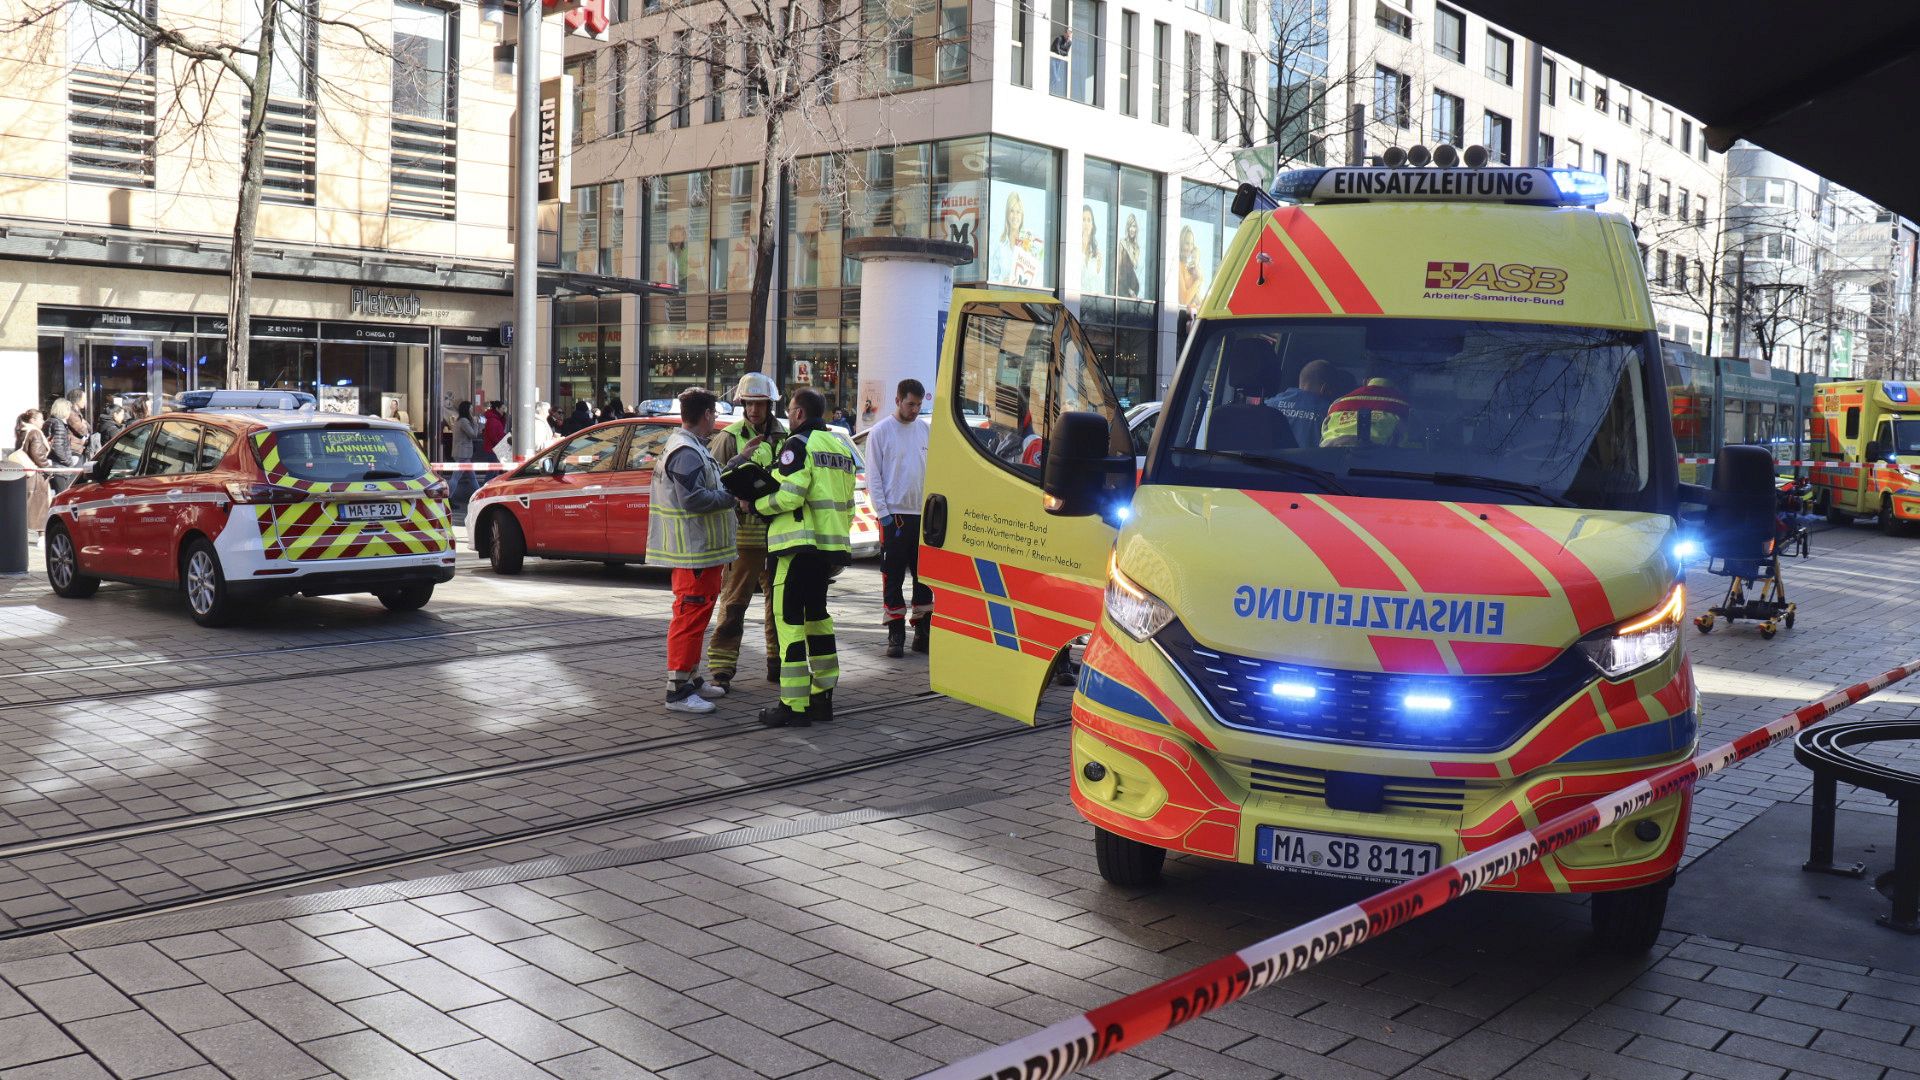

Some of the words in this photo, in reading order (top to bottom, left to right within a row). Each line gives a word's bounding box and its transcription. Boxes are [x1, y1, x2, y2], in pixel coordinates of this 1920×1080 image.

[539, 97, 556, 184] Pletzsch
[1334, 172, 1534, 195] EINSATZLEITUNG
[941, 196, 979, 208] Müller
[1456, 263, 1569, 295] ASB
[352, 288, 421, 316] Pletzsch
[1423, 291, 1565, 306] Arbeiter-Samariter-Bund
[267, 325, 304, 333] ZENITH
[322, 434, 383, 443] FEUERWEHR
[325, 444, 388, 453] MANNHEIM
[356, 454, 376, 463] 112
[348, 505, 364, 516] MA
[370, 505, 376, 516] F
[379, 504, 397, 516] 239
[964, 508, 1048, 534] Arbeiter-Samariter-Bund
[963, 521, 1032, 546] Baden-Württemberg
[962, 534, 985, 547] Region
[986, 541, 1024, 556] Mannheim
[1031, 549, 1082, 569] Rhein-Neckar
[1274, 834, 1306, 864] MA
[1326, 841, 1360, 869] SB
[1367, 845, 1431, 876] 8111
